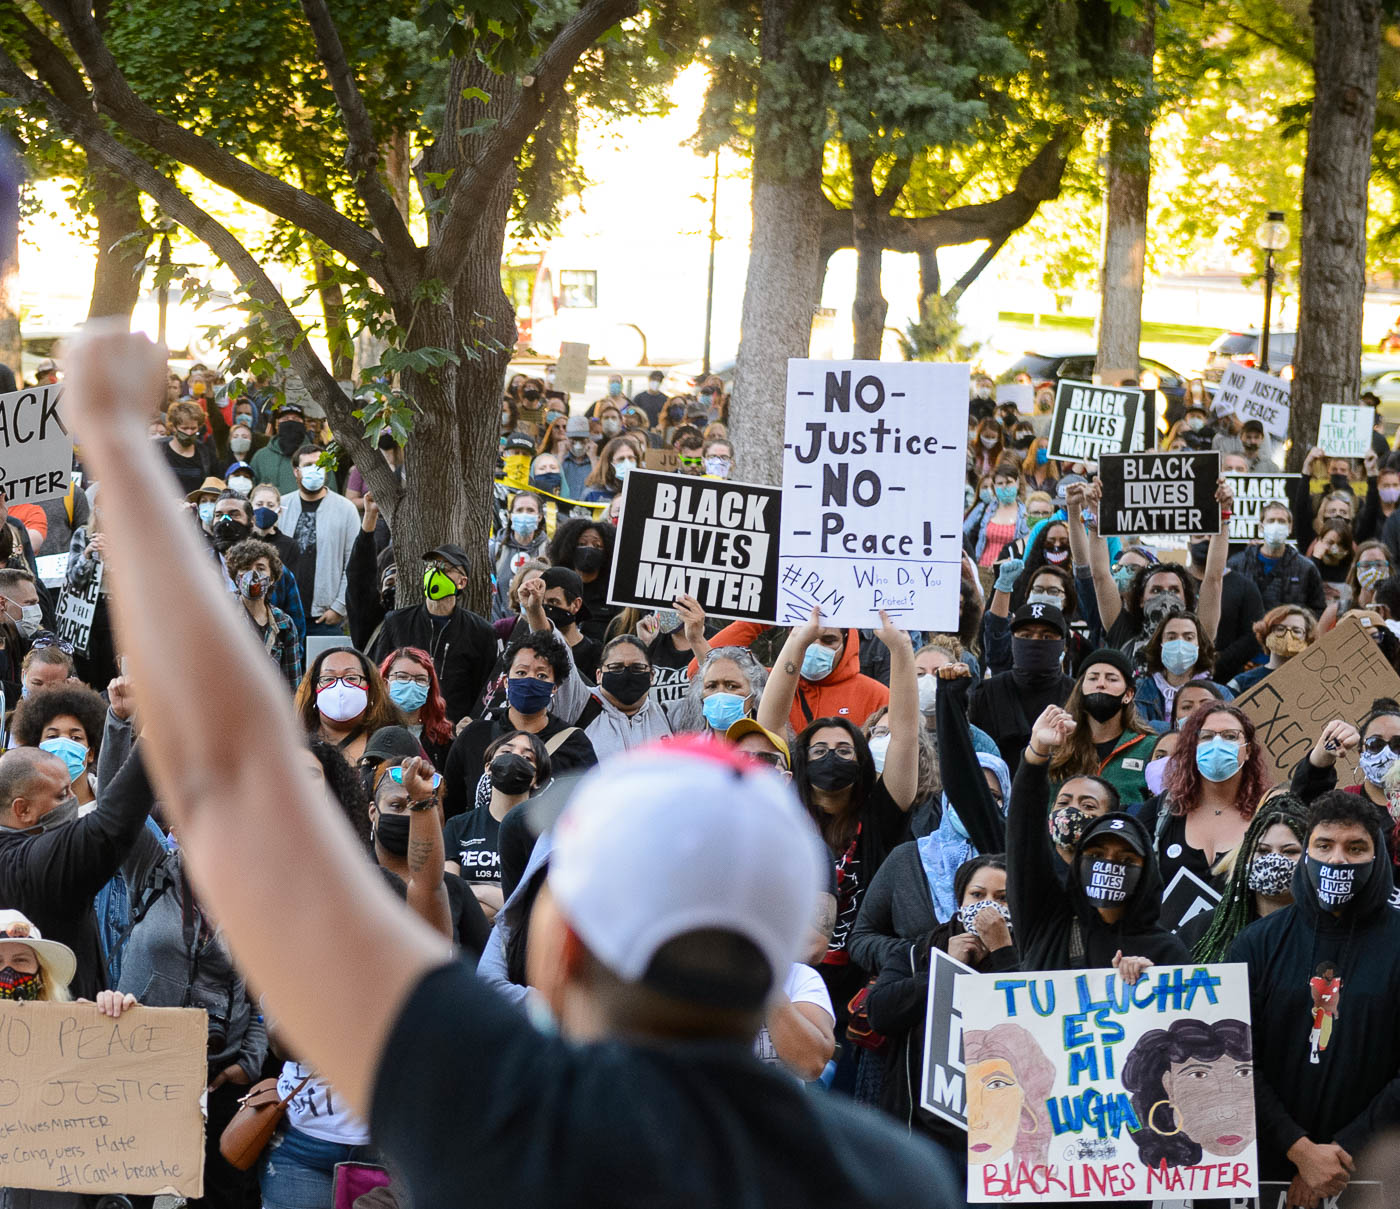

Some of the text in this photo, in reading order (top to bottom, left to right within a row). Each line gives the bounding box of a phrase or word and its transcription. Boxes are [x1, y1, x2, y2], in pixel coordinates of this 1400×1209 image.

[1228, 372, 1246, 390] NO
[1070, 388, 1128, 417] BLACK
[1242, 400, 1279, 425] PEACE
[1072, 413, 1117, 437] LIVES
[1330, 407, 1361, 424] LET
[1322, 424, 1357, 440] THEM
[1059, 433, 1122, 460] MATTER
[1321, 440, 1367, 454] BREATHE
[1123, 457, 1195, 480] BLACK
[653, 482, 770, 532] BLACK
[1130, 484, 1189, 506] LIVES
[1116, 508, 1202, 532] MATTER
[657, 524, 753, 570] LIVES
[634, 562, 763, 613] MATTER
[853, 565, 942, 589] Who Do You
[782, 564, 845, 616] #BLM
[873, 589, 916, 608] Protect?
[1337, 622, 1389, 690] THE
[1301, 646, 1360, 705] DOES
[1110, 819, 1125, 830] 3
[475, 870, 492, 878] LOS
[1092, 861, 1126, 876] BLACK
[1093, 873, 1121, 888] LIVES
[1320, 865, 1355, 880] BLACK
[1086, 885, 1126, 902] MATTER
[1321, 879, 1350, 893] LIVES
[994, 967, 1221, 1017] TU LUCHA
[1321, 994, 1332, 1002] 7
[58, 1017, 173, 1060] PEACE
[1063, 1008, 1126, 1052] ES
[1067, 1045, 1115, 1086] MI
[41, 1079, 185, 1107] JUSTICE
[1045, 1087, 1144, 1139] LUCHA
[95, 1135, 137, 1156] Hate
[125, 1161, 183, 1181] breathe
[983, 1157, 1252, 1198] BLACK LIVES MATTER
